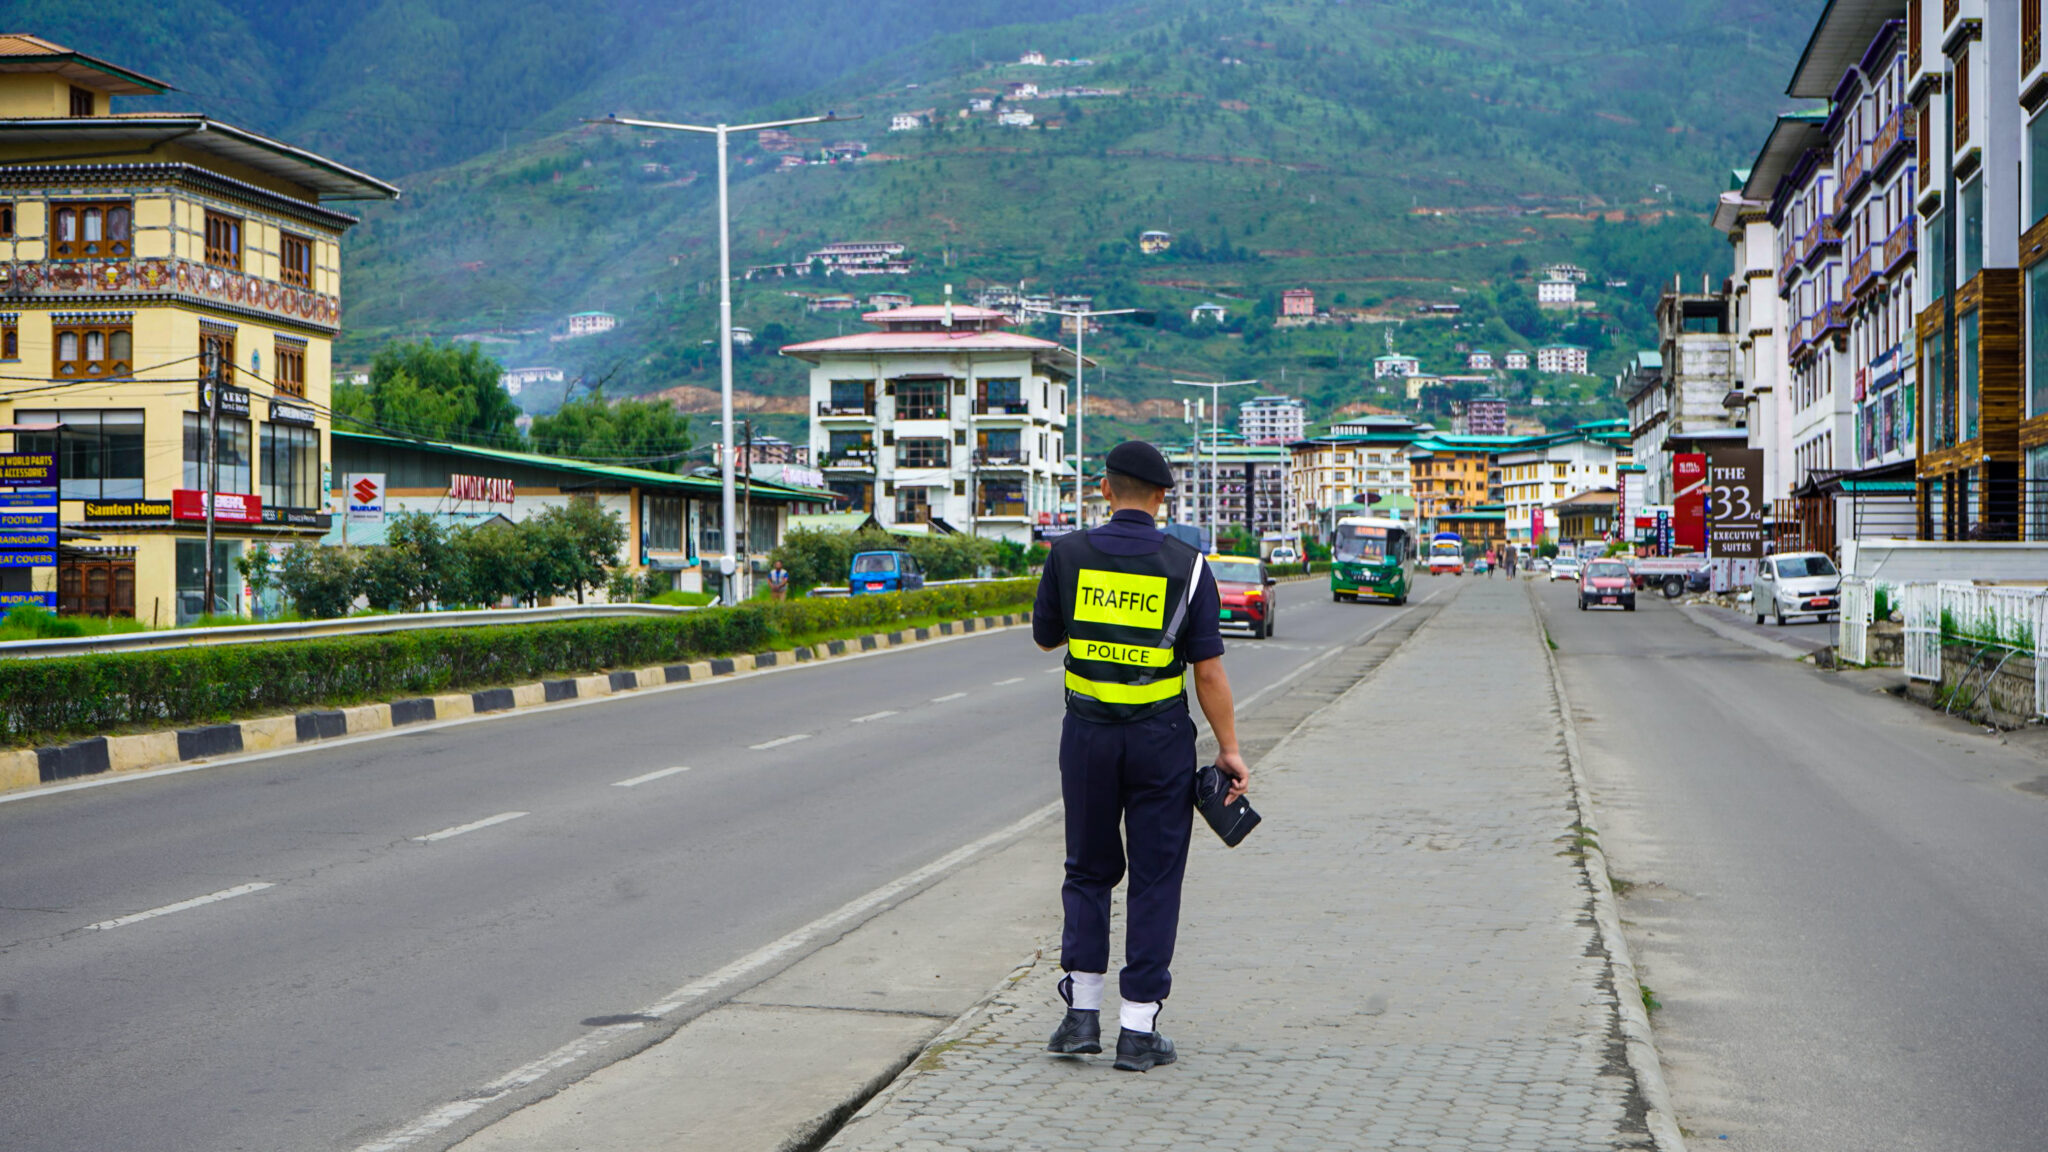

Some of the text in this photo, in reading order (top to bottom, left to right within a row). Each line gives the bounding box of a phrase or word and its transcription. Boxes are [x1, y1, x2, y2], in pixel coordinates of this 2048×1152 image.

[6, 455, 30, 466] WORLD
[31, 455, 53, 466] PARTS
[4, 467, 48, 478] ACCESSORIES
[1713, 467, 1745, 480] THE
[486, 477, 516, 504] SALES
[86, 503, 132, 516] Samten
[134, 502, 170, 516] Home
[349, 505, 382, 513] SUZUKI
[2, 516, 43, 524] FOOTMAT
[1713, 531, 1760, 541] EXECUTIVE
[1722, 543, 1752, 552] SUITES
[16, 555, 53, 563] COVERS
[1081, 586, 1159, 613] TRAFFIC
[1086, 643, 1150, 664] POLICE
